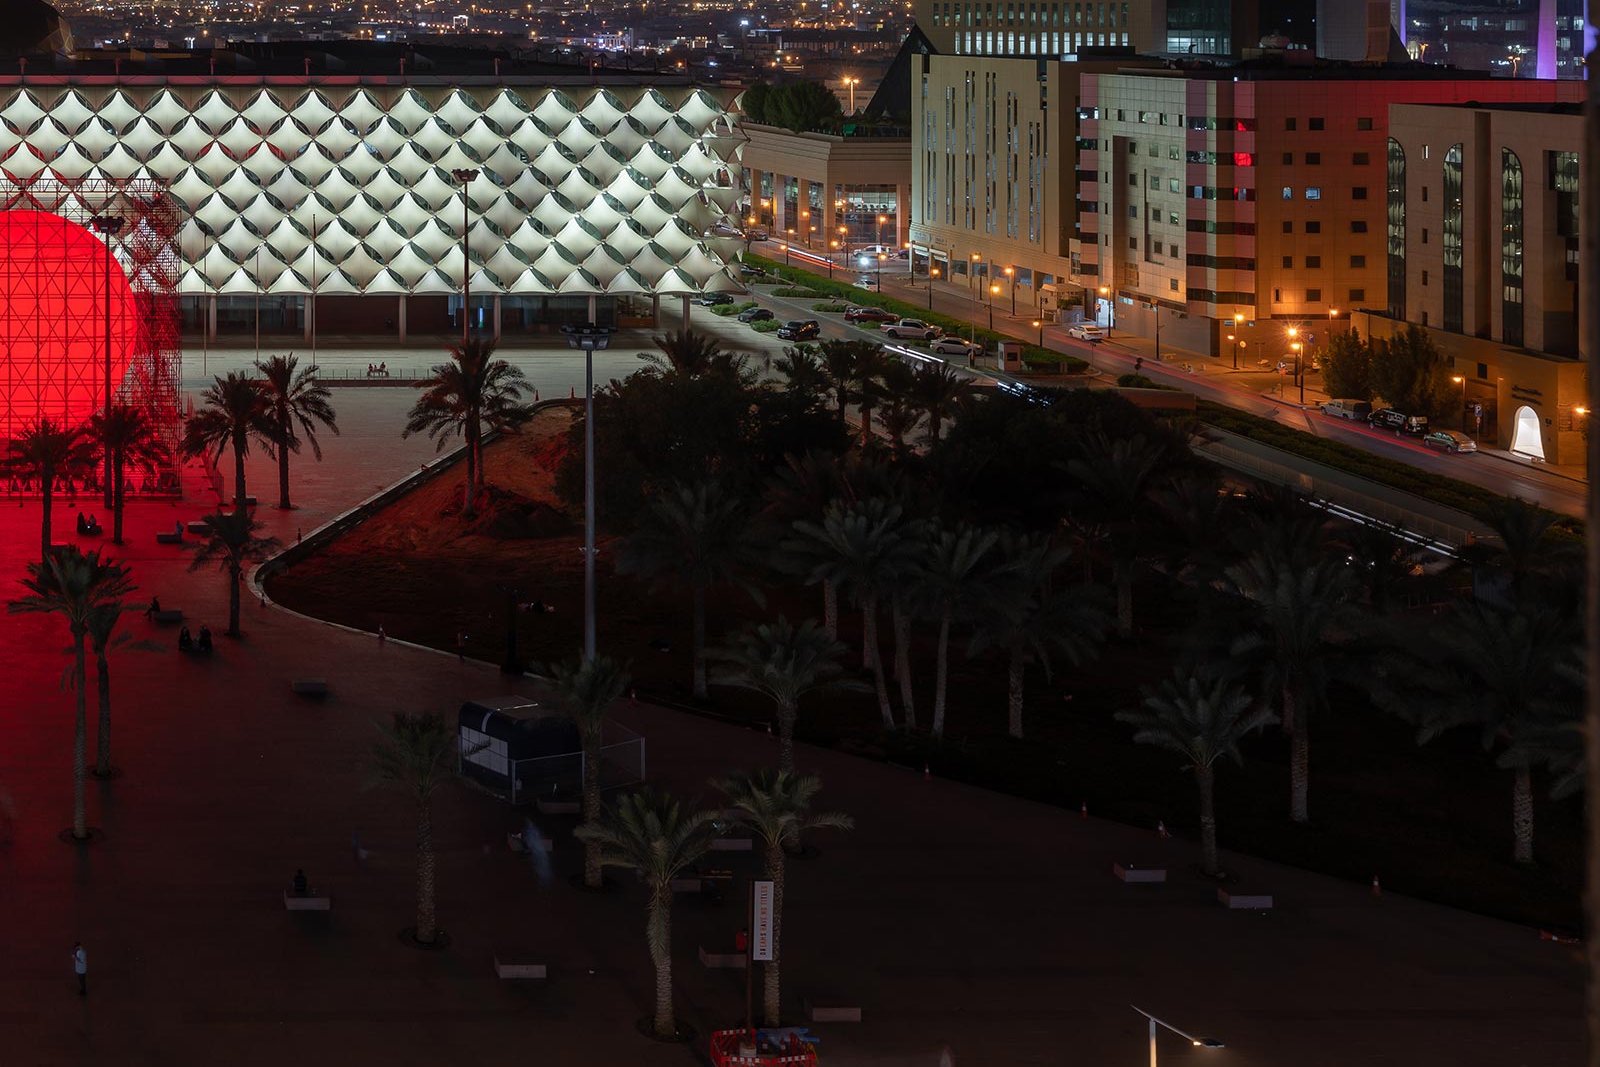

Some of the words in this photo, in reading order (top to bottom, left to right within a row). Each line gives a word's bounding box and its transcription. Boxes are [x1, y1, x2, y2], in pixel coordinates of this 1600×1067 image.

[760, 886, 768, 905] TITLES
[760, 907, 768, 915] NO
[760, 918, 768, 932] HAVE
[759, 933, 767, 956] DREAMS
